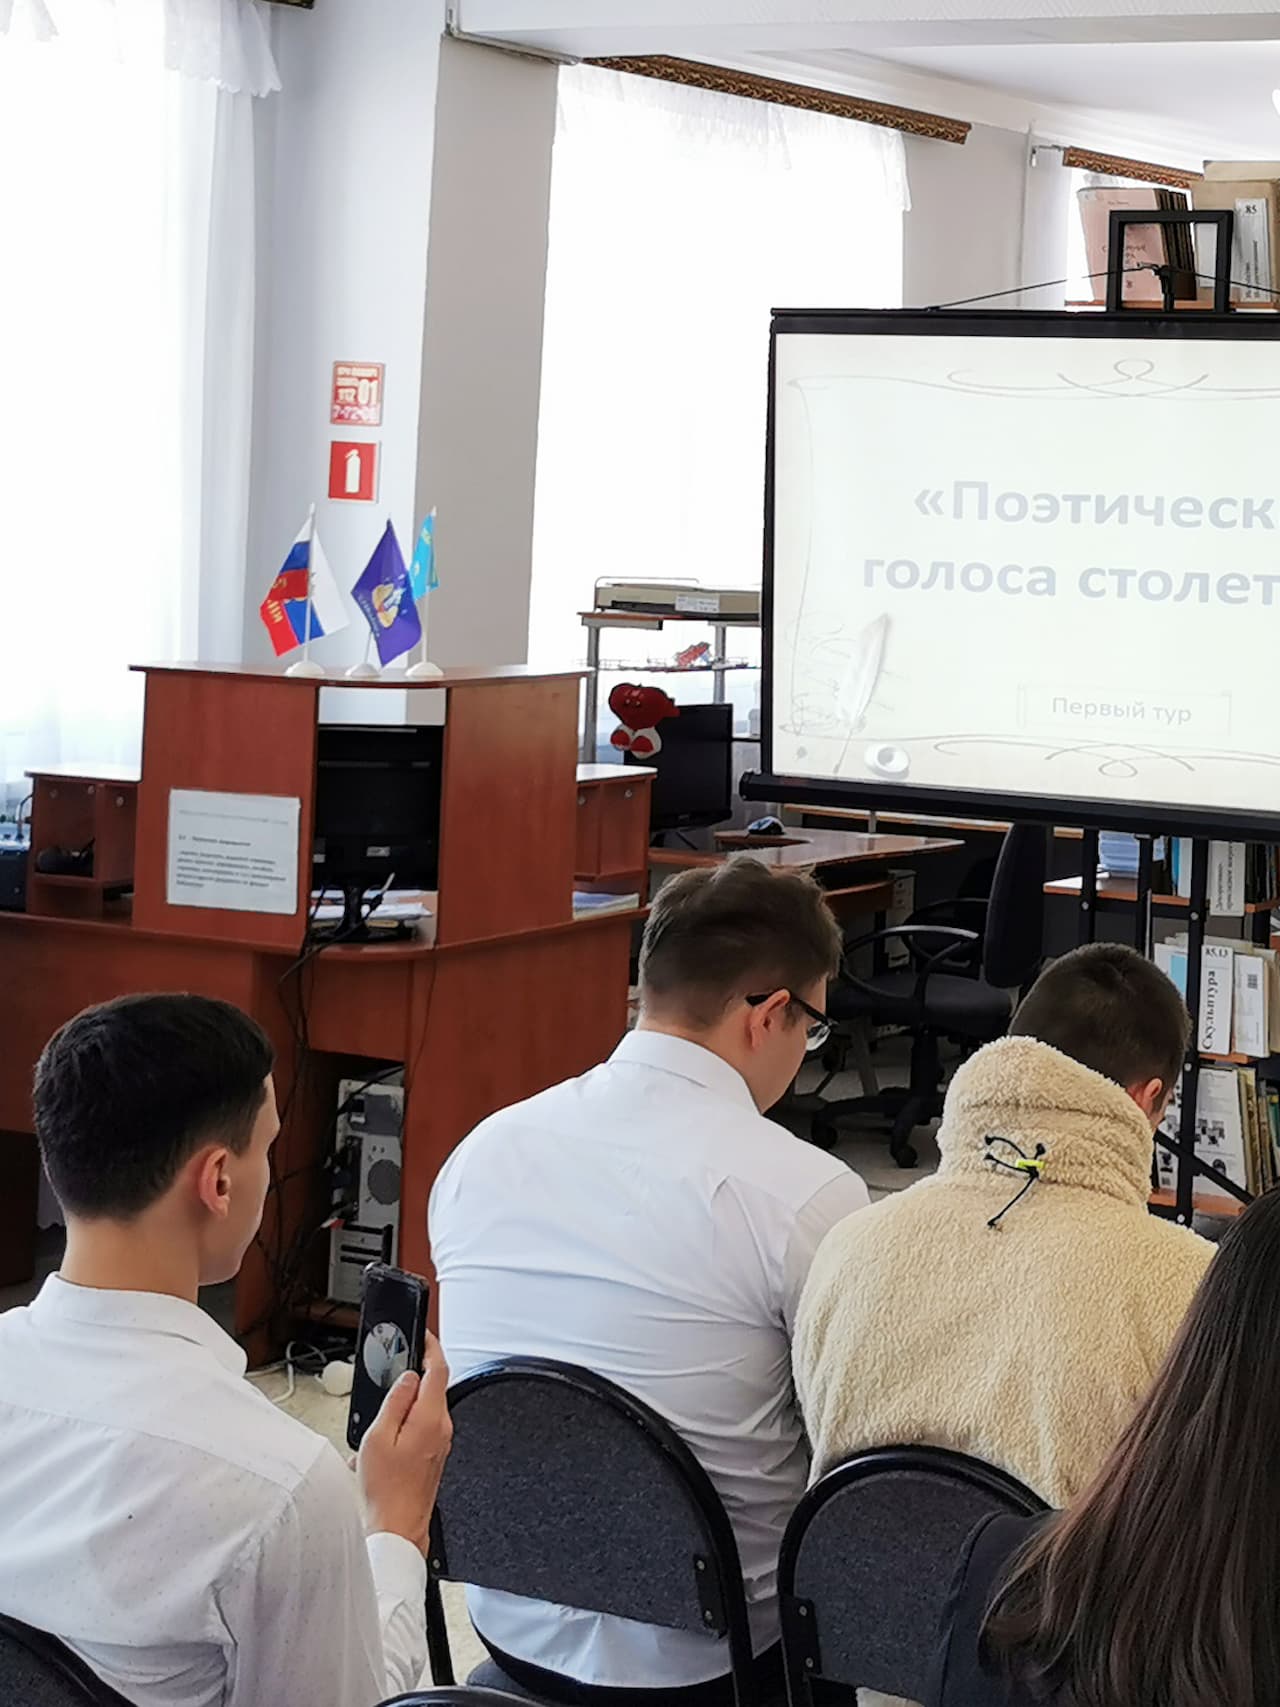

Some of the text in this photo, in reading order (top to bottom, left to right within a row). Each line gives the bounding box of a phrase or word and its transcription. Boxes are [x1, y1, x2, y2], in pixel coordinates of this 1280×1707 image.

[358, 379, 378, 406] 01
[863, 557, 1058, 597] голоса
[1052, 697, 1192, 725] Первый тур
[1202, 970, 1219, 1050] Скульптура
